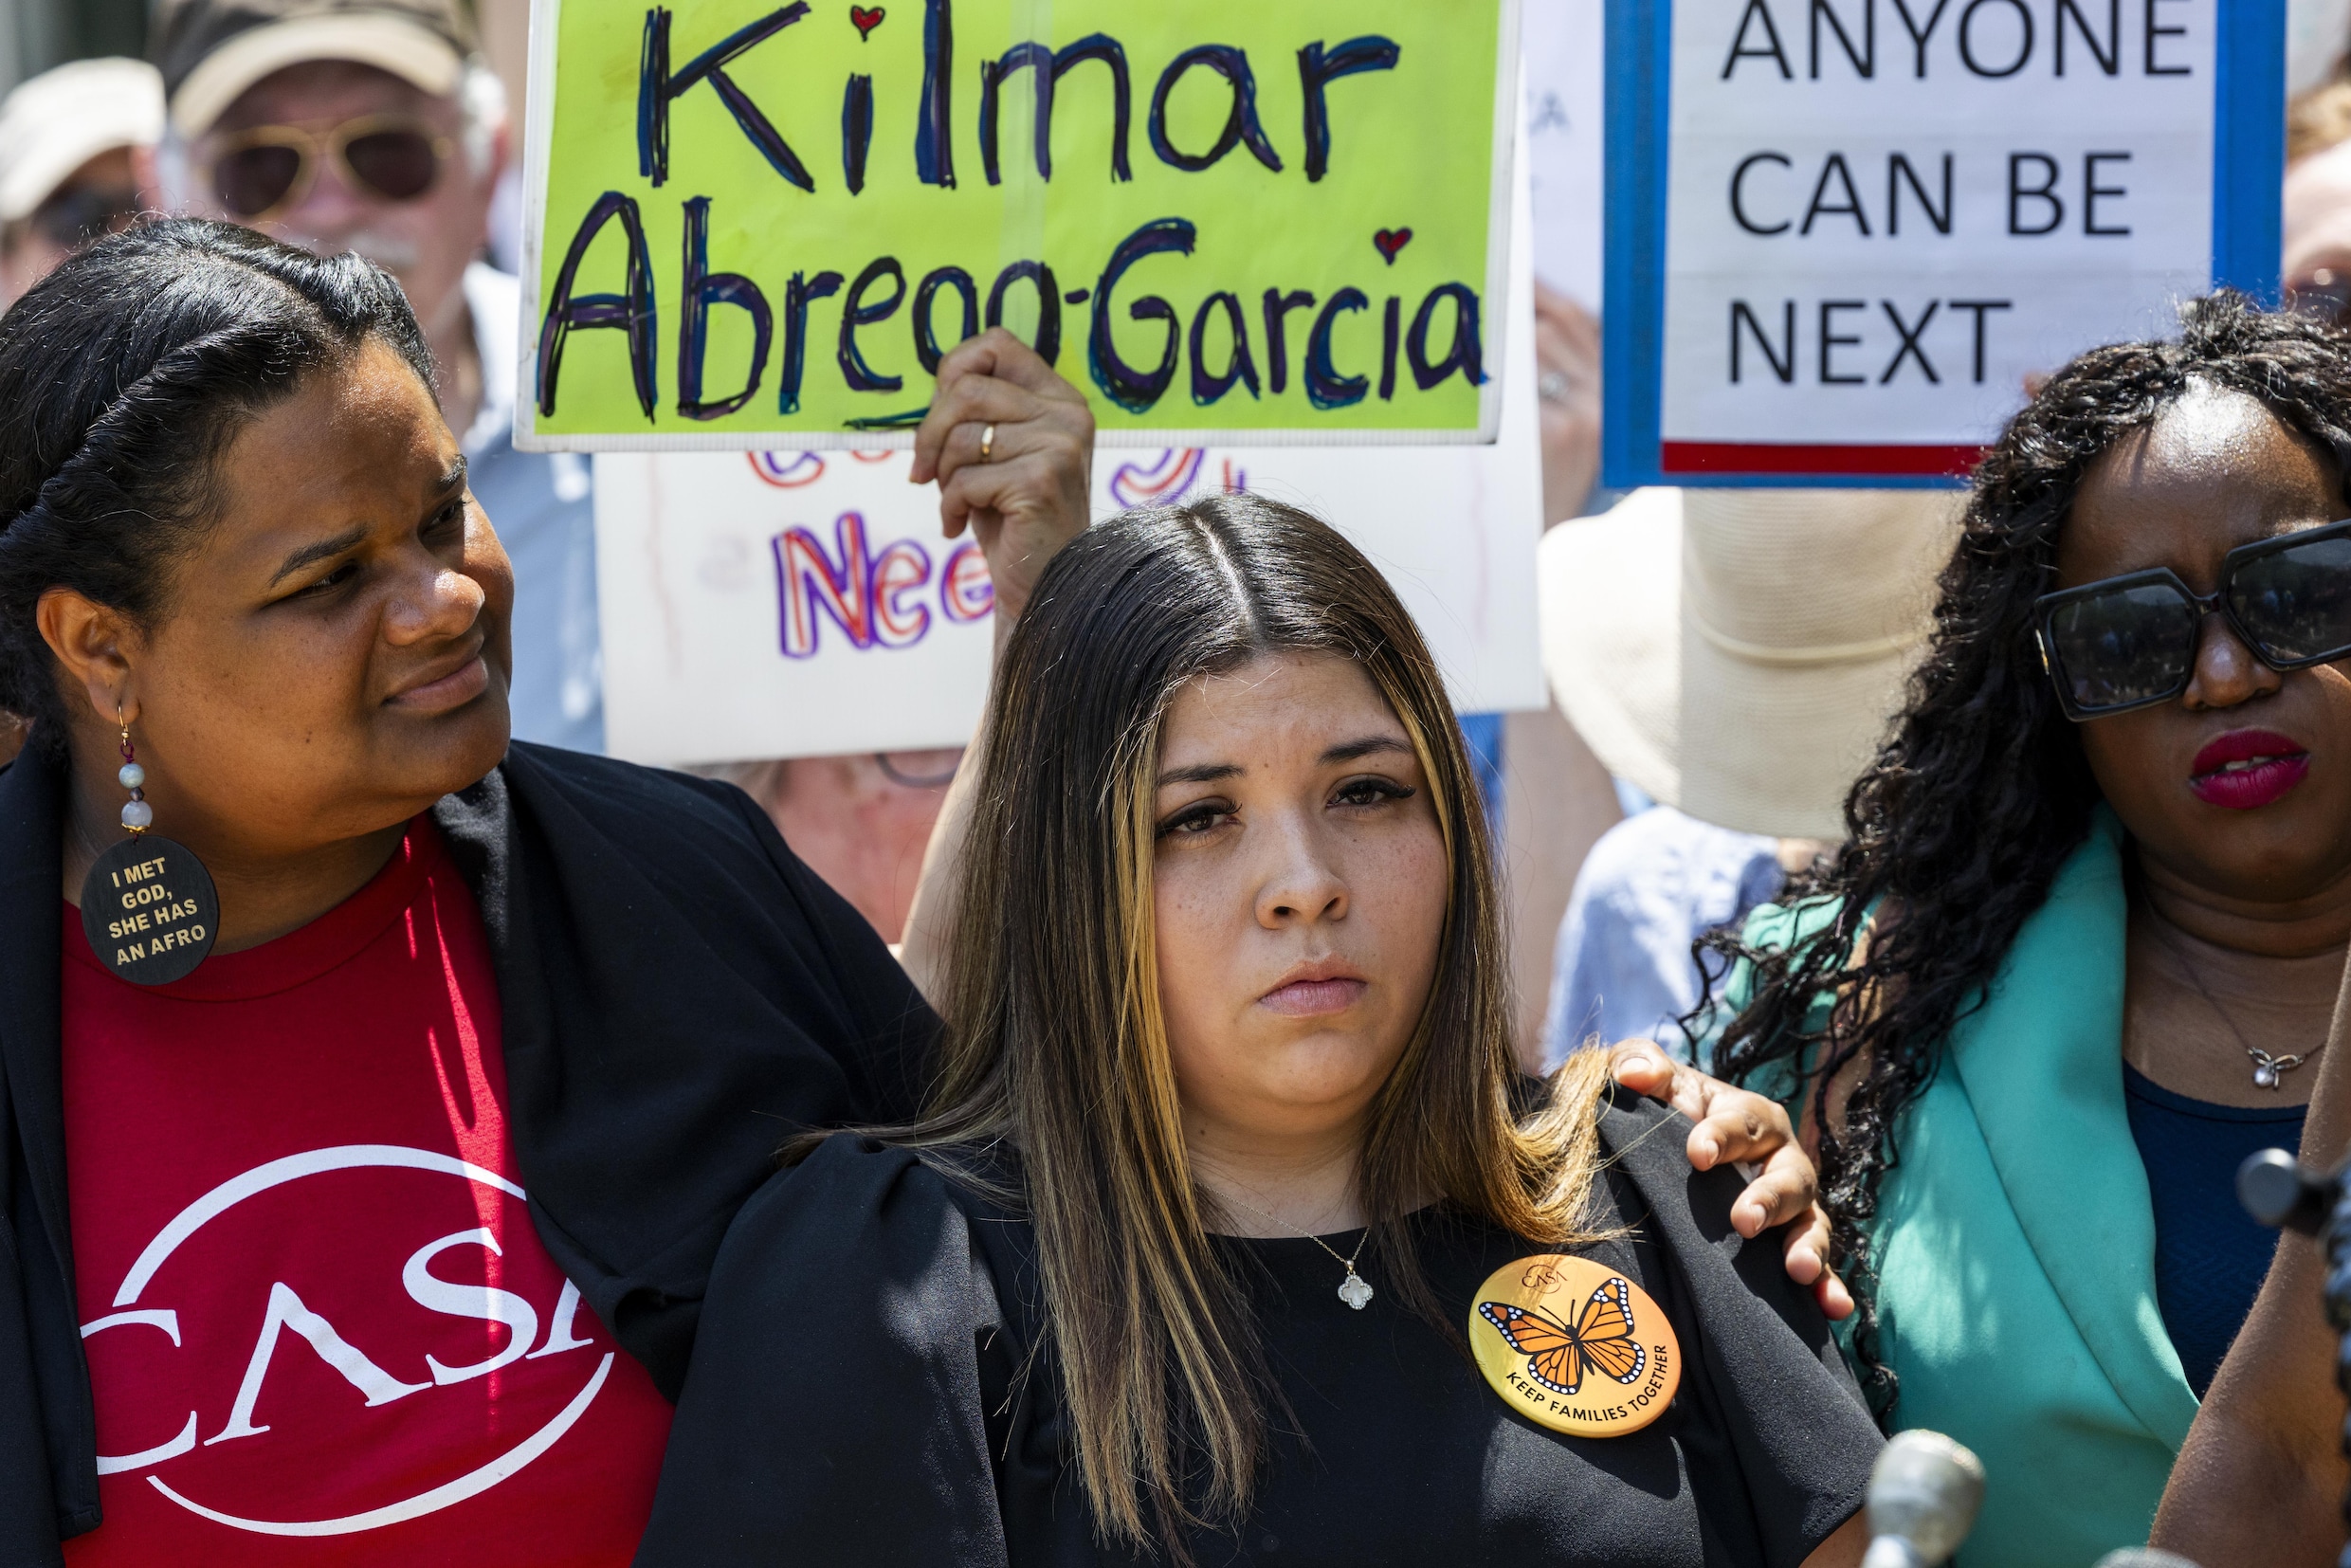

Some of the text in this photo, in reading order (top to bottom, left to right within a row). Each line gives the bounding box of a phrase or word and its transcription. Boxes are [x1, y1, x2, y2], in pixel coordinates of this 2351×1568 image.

[1721, 0, 2193, 81] ANYONE
[637, 0, 1400, 196] Kilmar
[1728, 151, 2133, 238] CAN BE
[1728, 300, 2014, 386] NEXT
[111, 856, 166, 888] I MET
[121, 884, 173, 910] GOD,
[108, 899, 198, 939] SHE HAS
[117, 924, 206, 966] AN AFRO
[1522, 1270, 1568, 1288] CASA
[1505, 1345, 1668, 1422] KEEP FAMILIES TOGETHER
